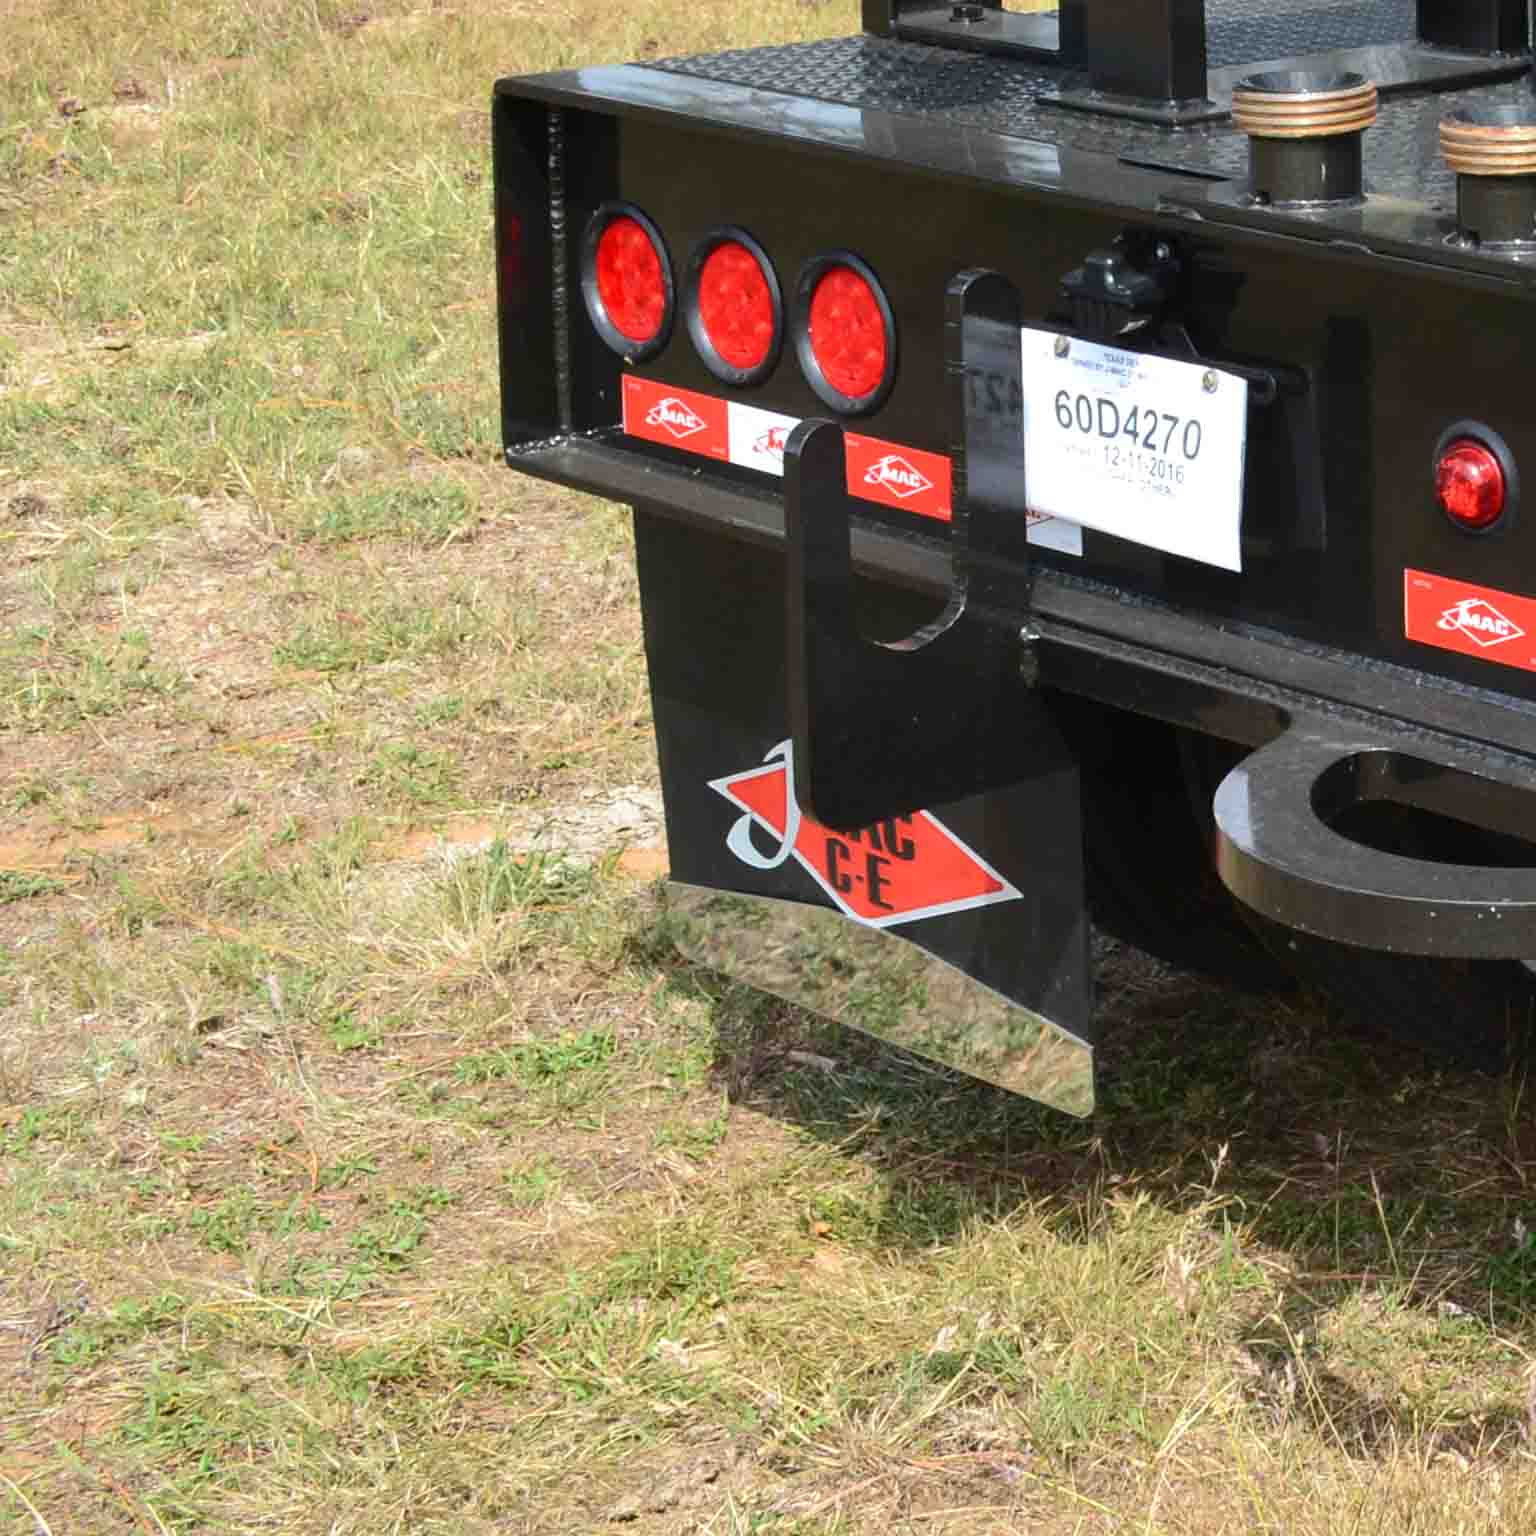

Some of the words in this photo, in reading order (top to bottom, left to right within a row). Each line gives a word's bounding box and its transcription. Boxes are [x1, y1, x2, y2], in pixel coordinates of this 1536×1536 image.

[1054, 389, 1202, 461] 60D4270
[1103, 445, 1185, 484] 12-11-2016
[825, 836, 895, 911] C-E
